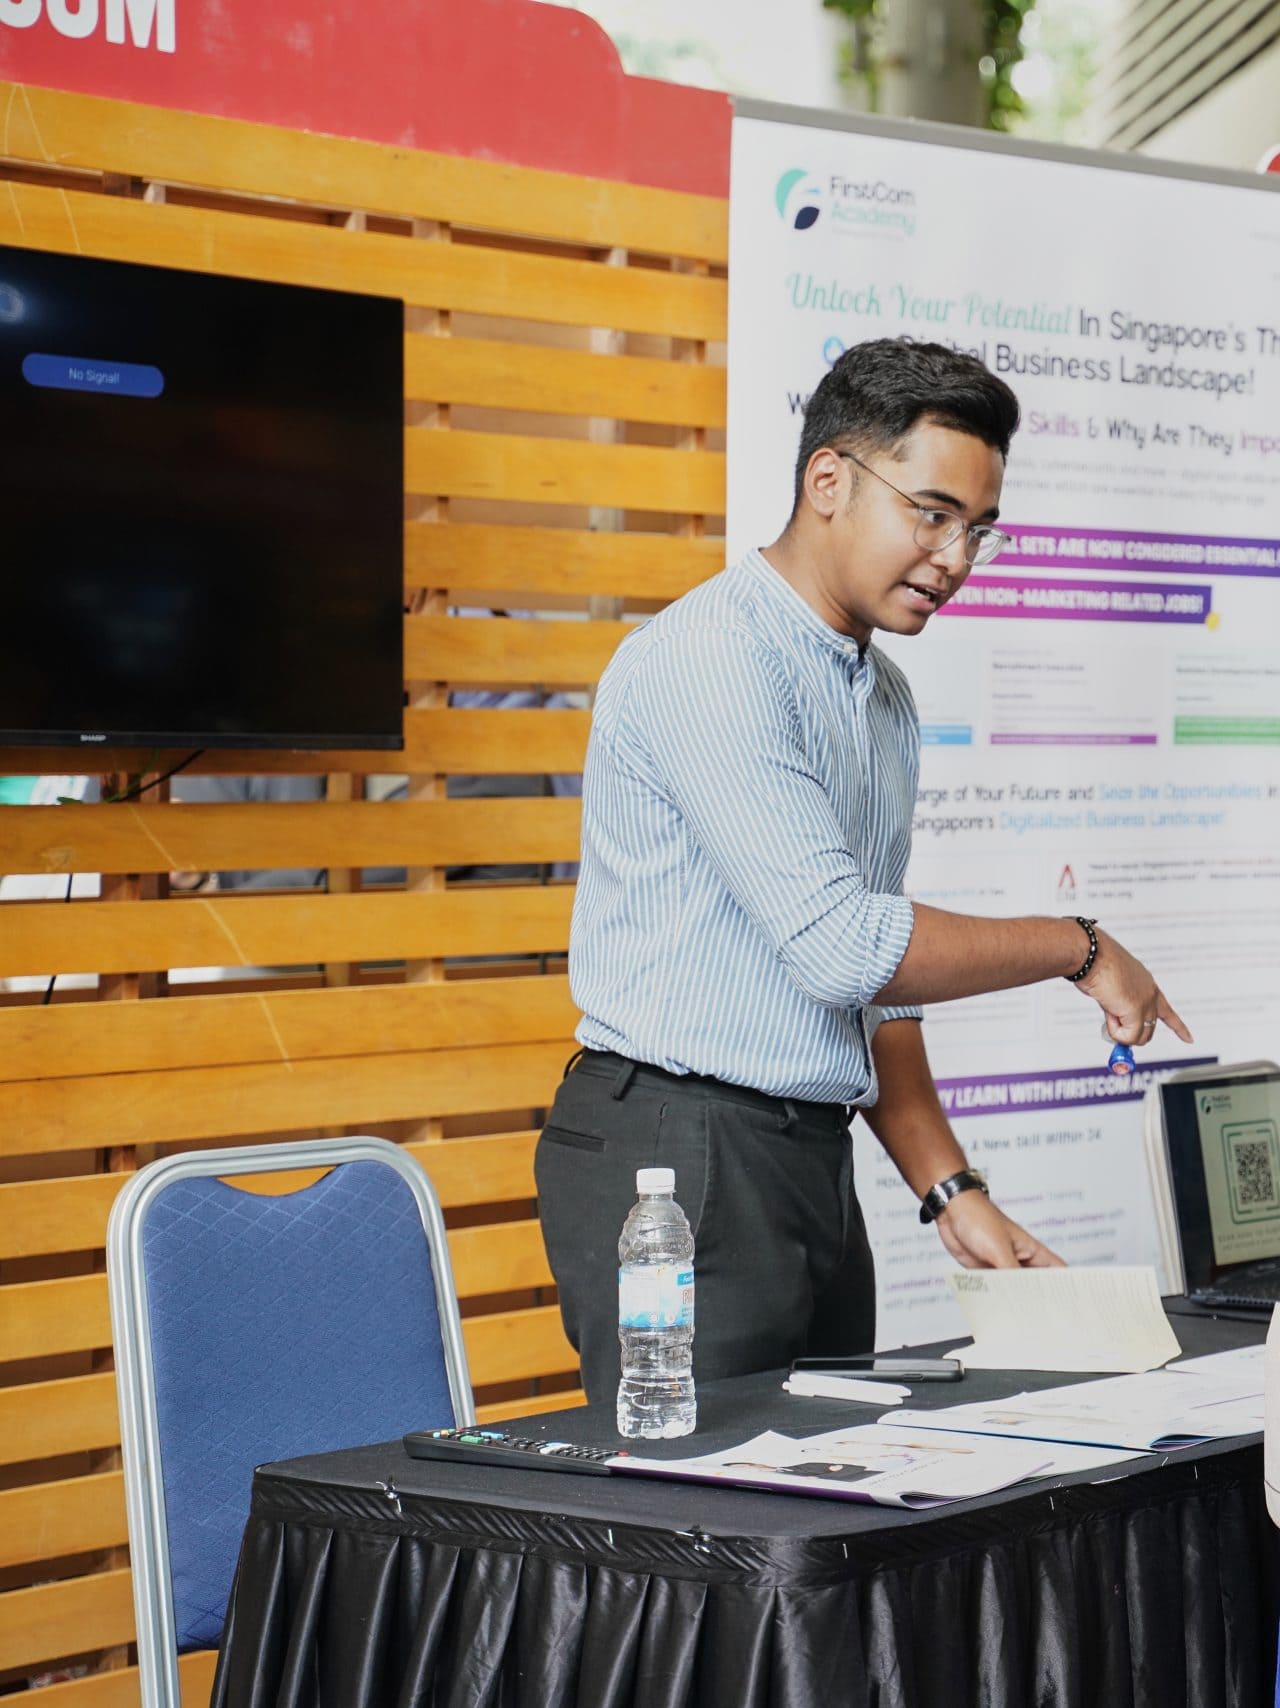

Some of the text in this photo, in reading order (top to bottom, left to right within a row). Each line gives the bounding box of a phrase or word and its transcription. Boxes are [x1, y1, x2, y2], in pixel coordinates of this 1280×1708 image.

[831, 176, 916, 206] FirstCom
[832, 202, 916, 236] Academy
[786, 272, 881, 316] Unlock
[889, 284, 952, 323] Your
[959, 292, 1073, 335] Potential
[1079, 307, 1100, 337] In
[1110, 310, 1247, 354] Singapore's
[68, 367, 84, 381] No
[996, 344, 1112, 382] Business
[1120, 355, 1255, 400] Landscape!
[1028, 410, 1080, 437] Skills
[1106, 418, 1145, 450] Why
[1153, 422, 1181, 446] Are
[1188, 424, 1232, 456] They
[1020, 535, 1056, 556] SETS
[1057, 537, 1087, 558] ARE
[1088, 539, 1123, 559] NOW
[1126, 541, 1204, 564] CONSIDERED
[1205, 544, 1275, 567] ESSENTIAL
[1110, 591, 1164, 613] RELATED
[914, 786, 948, 808] arge
[954, 784, 968, 801] of
[974, 784, 1004, 801] Your
[1010, 783, 1060, 801] Future
[1068, 784, 1094, 801] and
[1087, 811, 1145, 828] Business
[957, 1083, 1008, 1109] LEARN
[1009, 1079, 1053, 1105] WITH
[1054, 1074, 1131, 1101] FIRSTCOM
